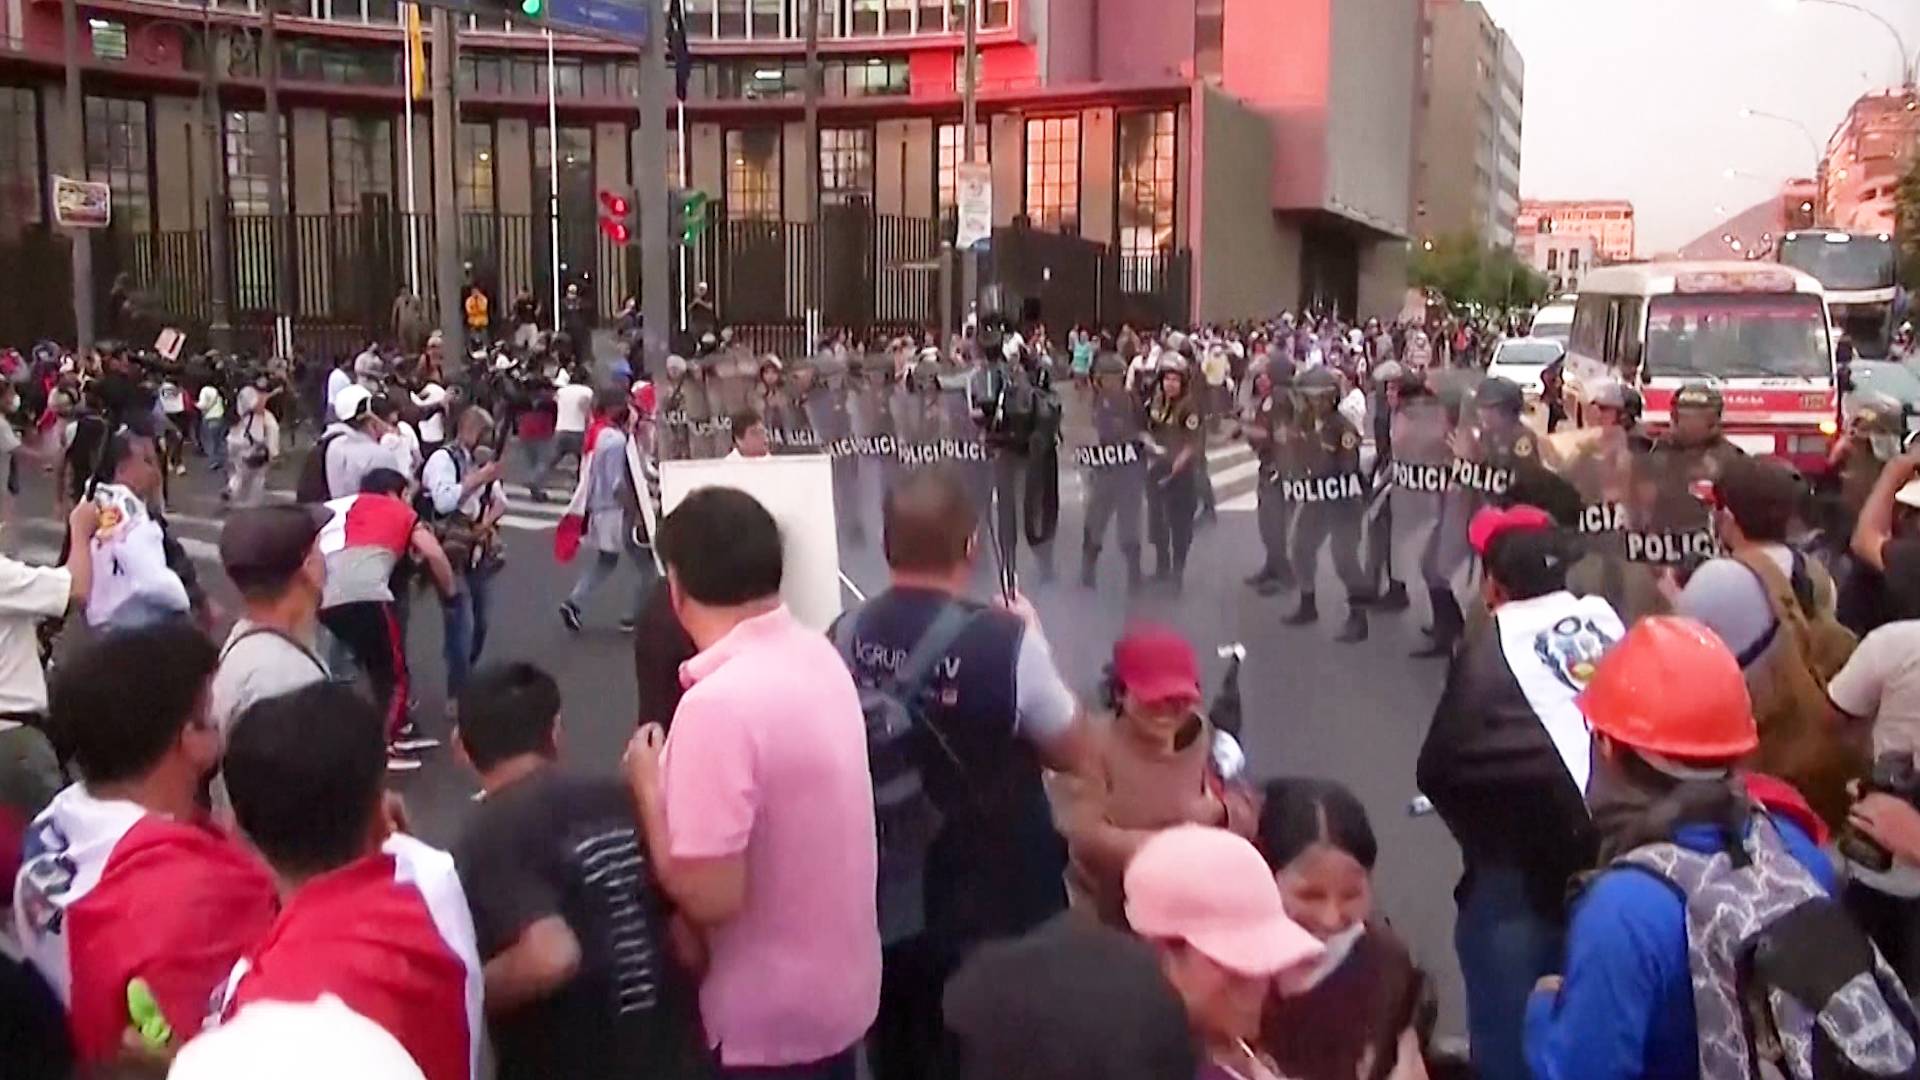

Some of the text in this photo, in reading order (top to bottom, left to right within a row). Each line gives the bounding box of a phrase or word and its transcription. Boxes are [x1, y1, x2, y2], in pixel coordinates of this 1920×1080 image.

[1074, 443, 1138, 467] POLICIA
[1282, 472, 1362, 502] POLICIA
[1392, 461, 1447, 492] POLICI
[1579, 502, 1627, 533] ICIA
[1627, 530, 1712, 561] POLIC
